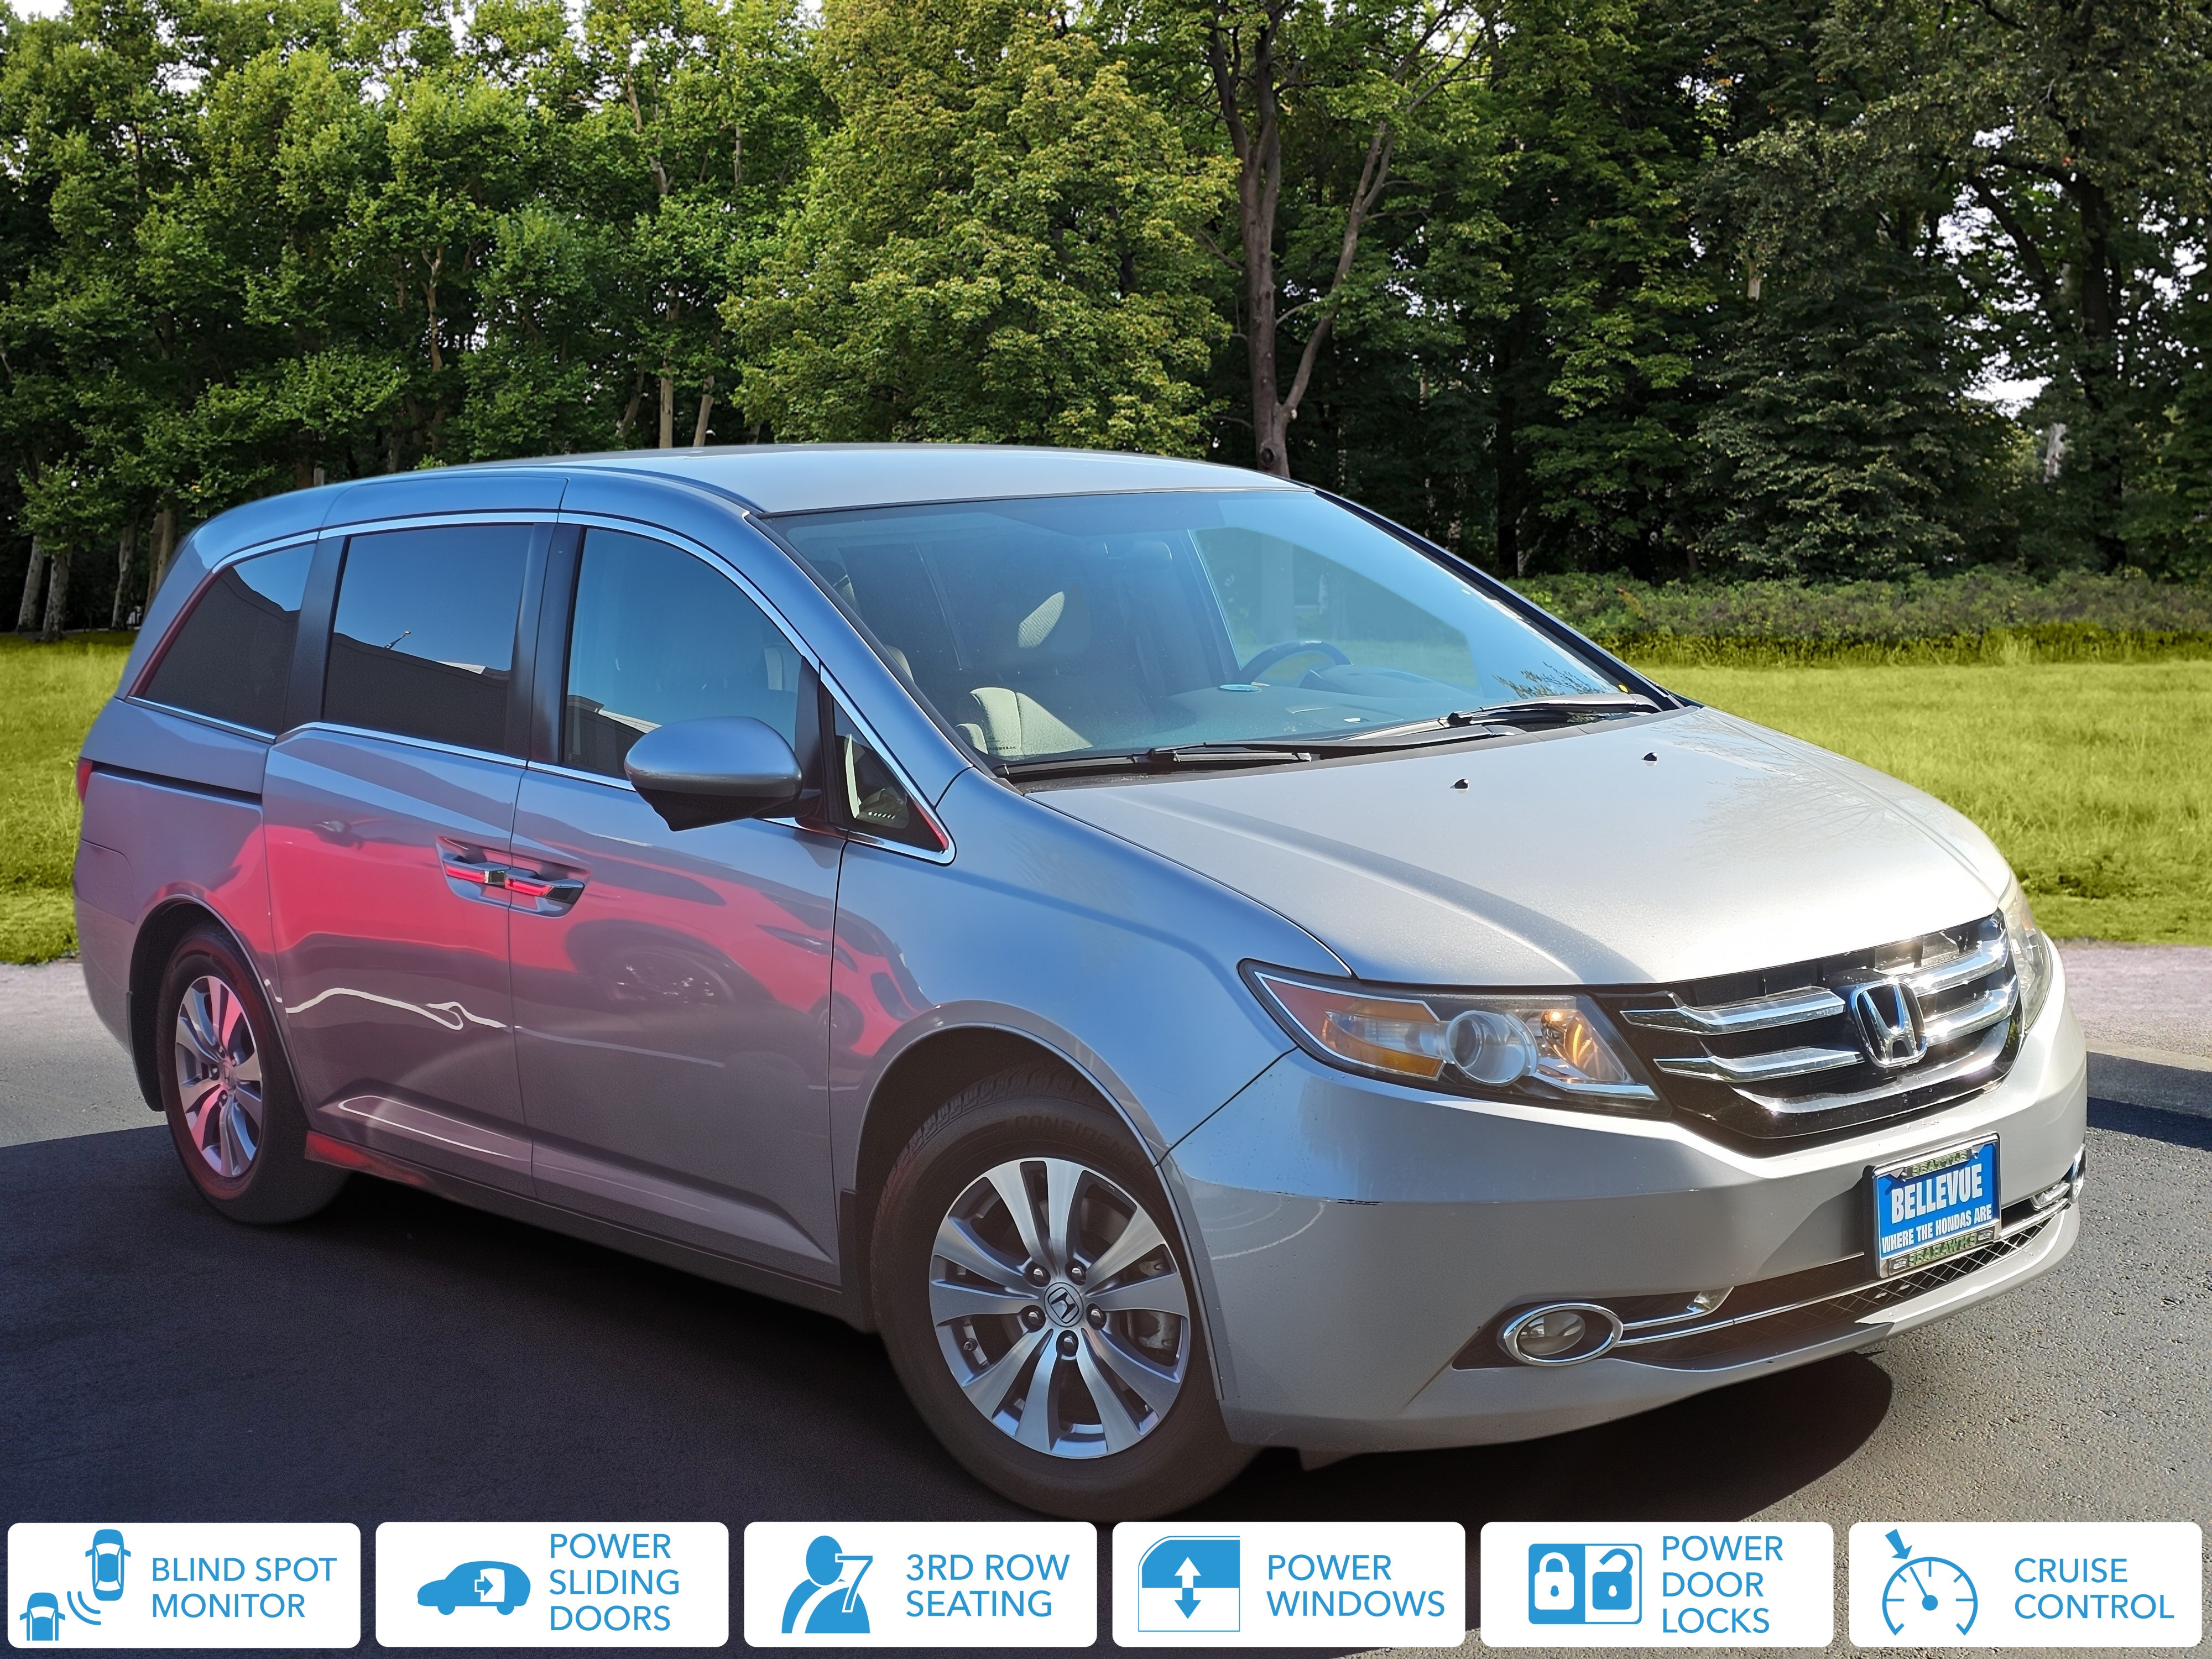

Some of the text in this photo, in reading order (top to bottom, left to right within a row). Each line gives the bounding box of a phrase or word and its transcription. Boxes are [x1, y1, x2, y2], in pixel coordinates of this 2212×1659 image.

[1912, 1150, 1967, 1177] SEATTLE
[1891, 1163, 1983, 1224] BELLEVUE
[1881, 1203, 1992, 1254] WHERE THE HONDAS ARE
[1908, 1232, 1977, 1267] SEAHAWKS
